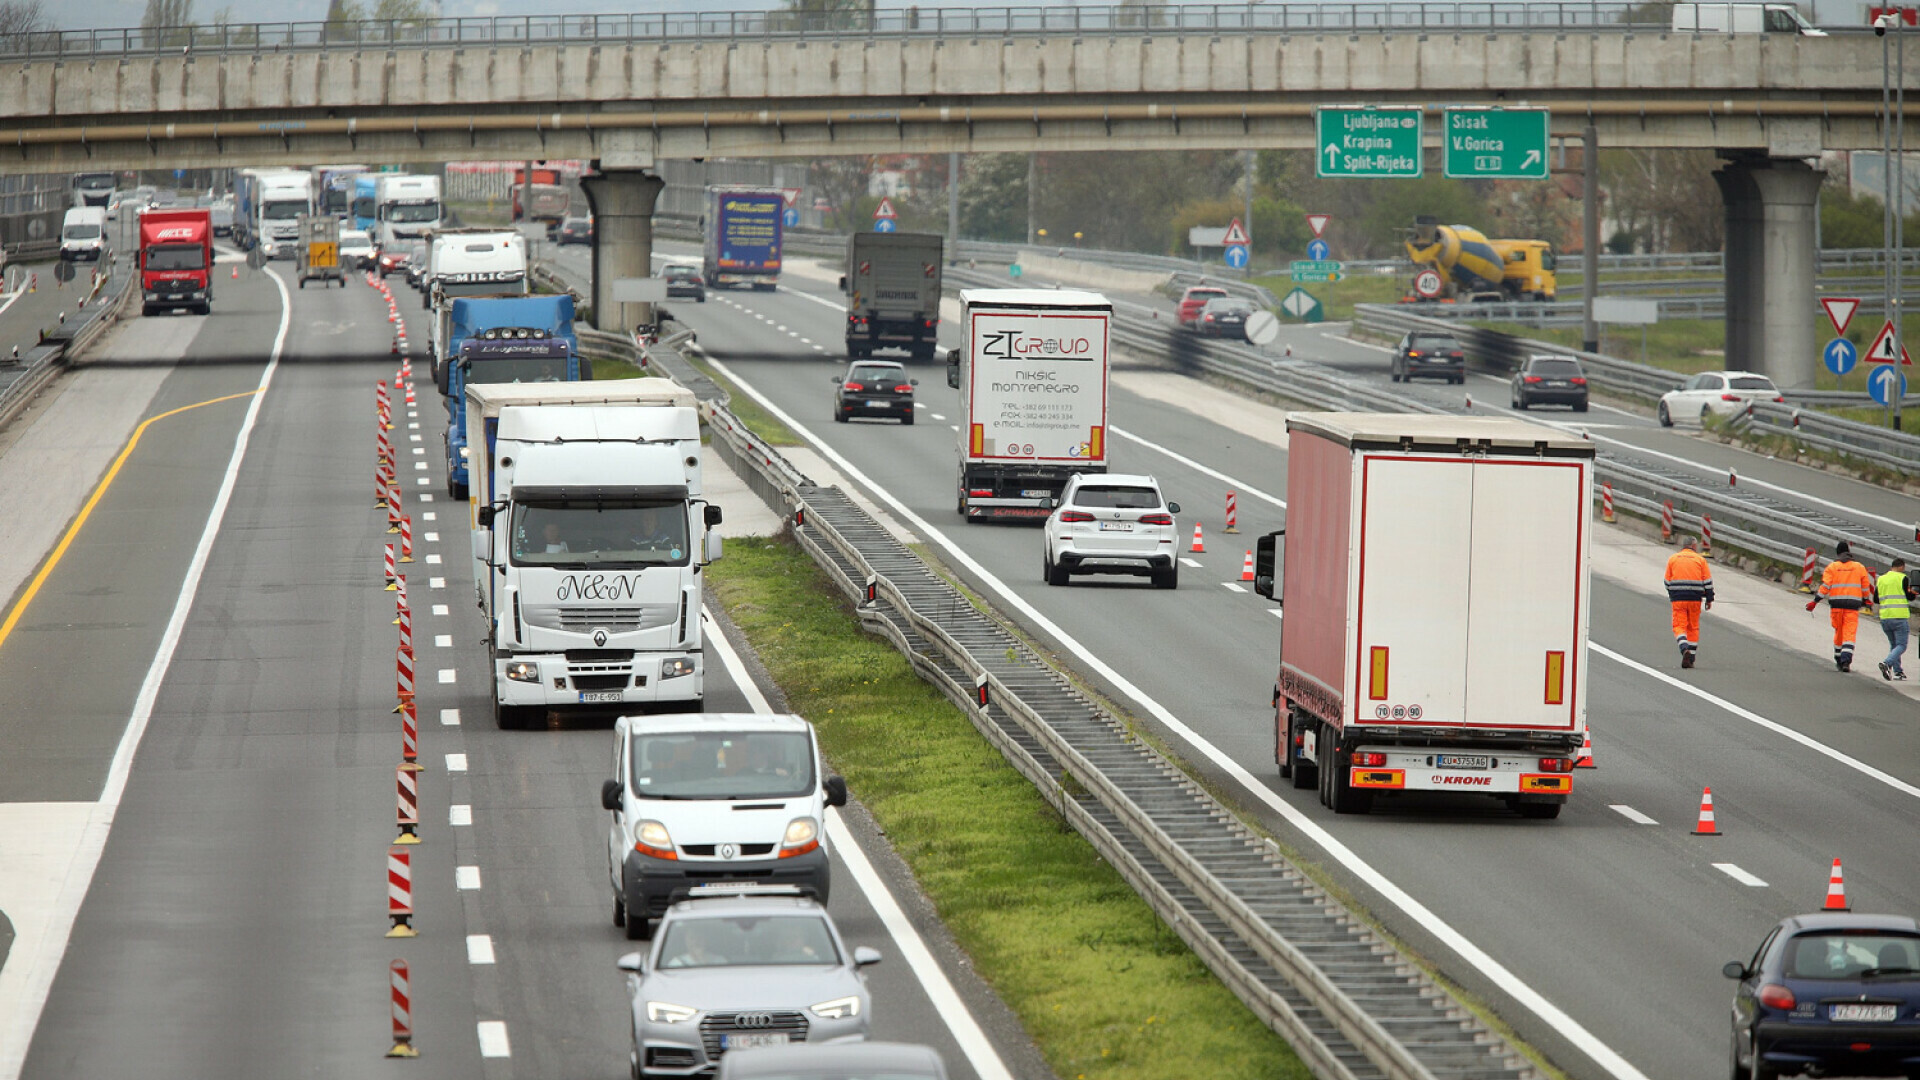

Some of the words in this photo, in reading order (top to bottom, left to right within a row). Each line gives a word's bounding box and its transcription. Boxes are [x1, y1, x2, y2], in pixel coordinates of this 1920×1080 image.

[1343, 114, 1399, 131] Ljubljana
[1452, 114, 1489, 129] Sisak
[1343, 135, 1392, 152] Krapina
[1343, 154, 1414, 173] Split-Rijeka
[1421, 278, 1437, 290] 40
[993, 507, 1053, 517] SCHWARZM
[557, 575, 641, 600] N&N
[1378, 708, 1388, 716] 70
[1394, 708, 1404, 716] 80
[1410, 708, 1420, 716] 90
[1456, 757, 1475, 766] 3753
[1444, 776, 1492, 786] KRONE
